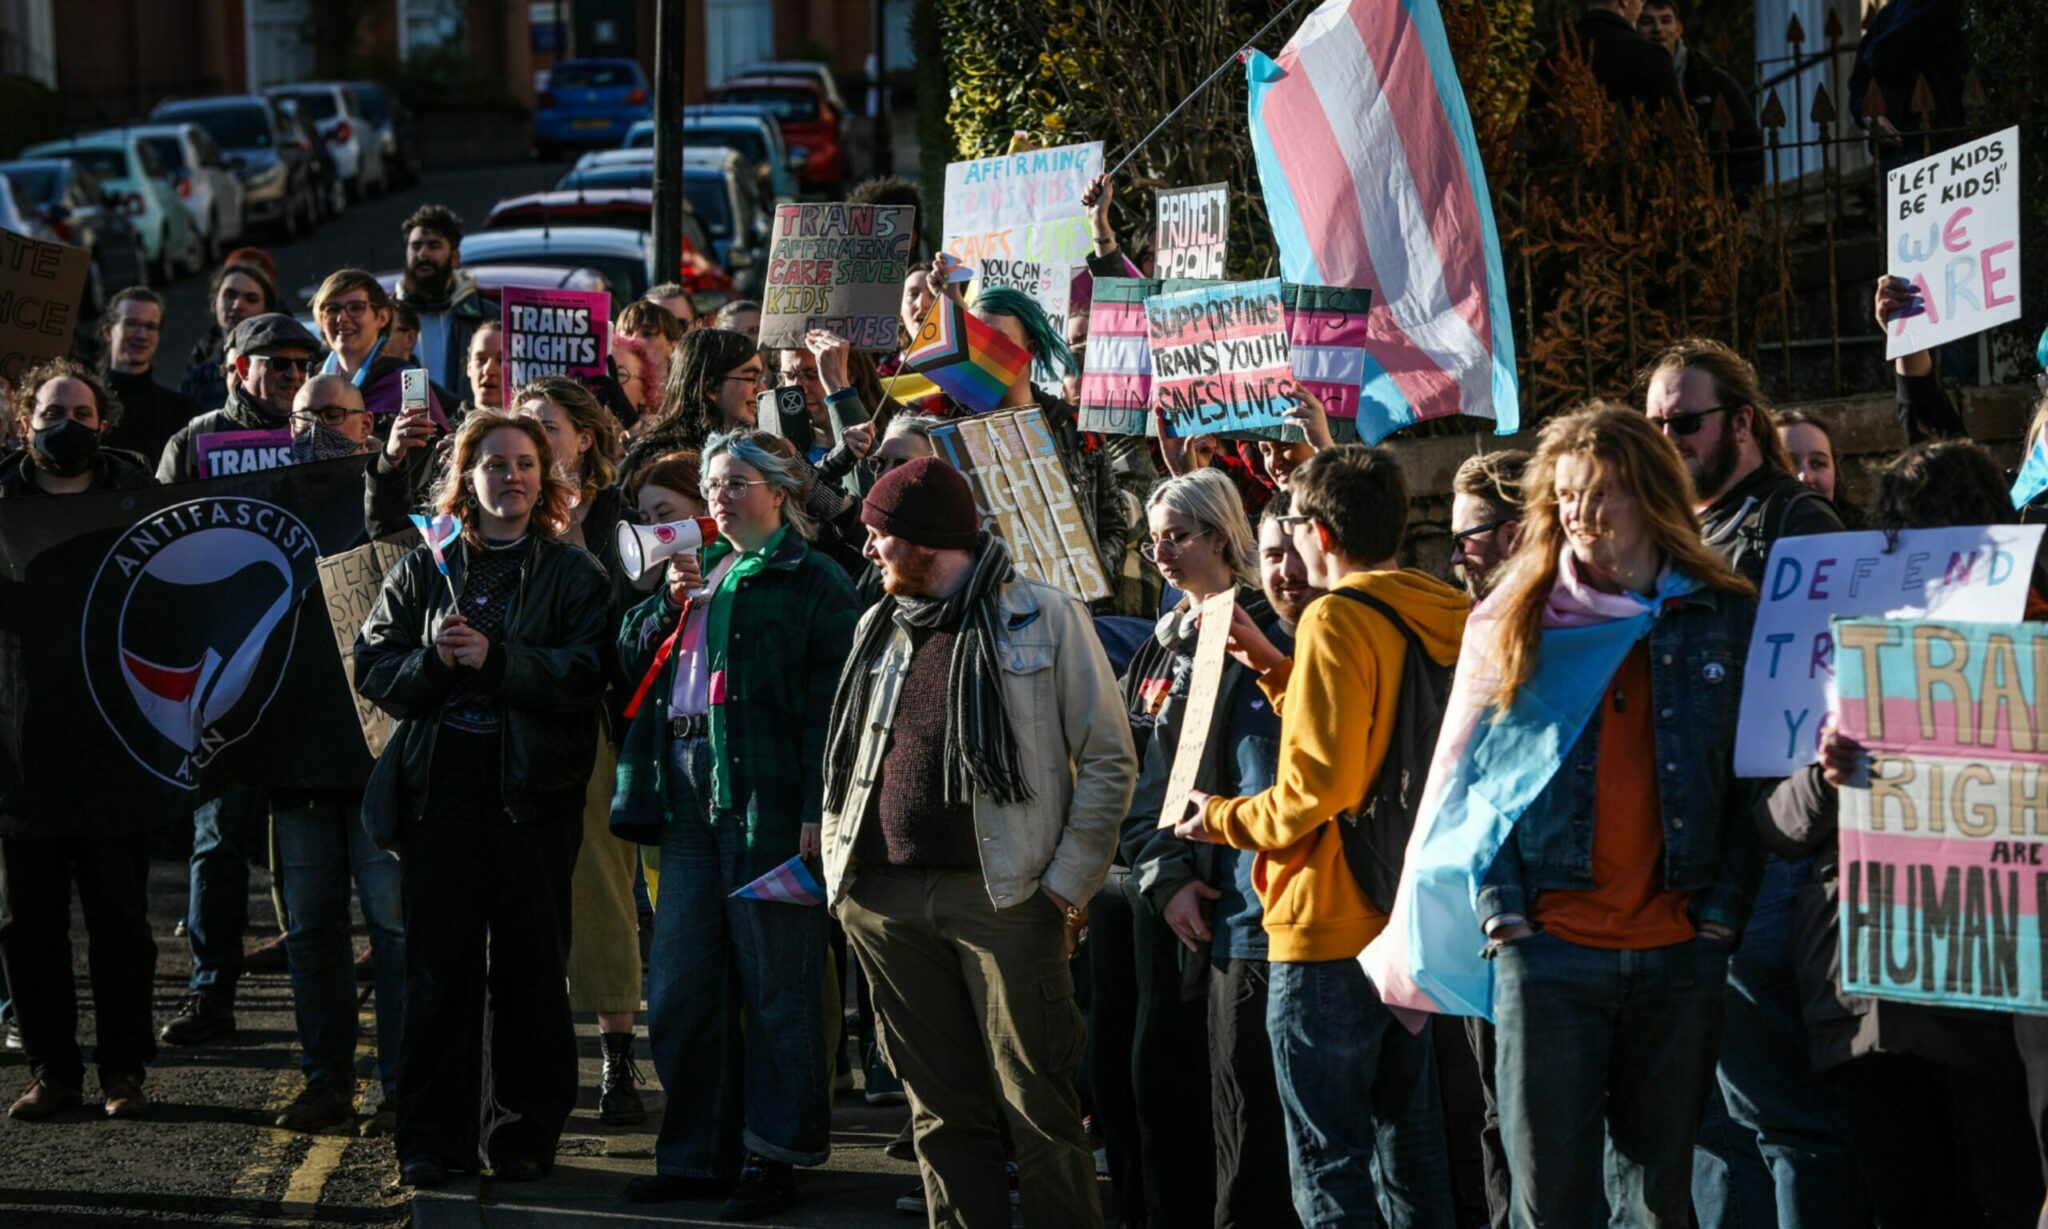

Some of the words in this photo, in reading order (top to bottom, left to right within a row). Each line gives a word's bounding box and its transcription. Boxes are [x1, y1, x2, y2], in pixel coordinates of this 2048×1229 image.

[964, 147, 1089, 185] AFFIRMING
[1950, 141, 2004, 176] KIDS
[952, 184, 1016, 214] TRANS
[1028, 177, 1075, 209] KIDS
[1899, 193, 1927, 220] BE
[777, 205, 899, 237] TRANS
[1158, 189, 1226, 249] PROTECT
[1898, 206, 1973, 263] WE
[772, 234, 910, 259] AFFIRMING
[948, 227, 1013, 267] SAVES
[768, 259, 832, 285] CARE
[835, 260, 906, 285] SAVES
[981, 259, 1009, 277] YOU
[1011, 260, 1040, 280] CAN
[766, 286, 834, 315] KIDS
[1895, 240, 2016, 337] ARE
[511, 305, 589, 335] TRANS
[1150, 293, 1279, 339] SUPPORTING
[511, 333, 596, 363] RIGHTS
[1152, 340, 1219, 377] TRANS
[1223, 332, 1289, 370] YOUTH
[1158, 380, 1227, 428] SAVES
[1230, 377, 1295, 419] LIVES
[208, 446, 292, 477] TRANS
[113, 501, 313, 579] ANTIFASCIST
[1770, 550, 2015, 602] DEFEND
[1990, 841, 2044, 865] ARE
[1848, 861, 2019, 997] HUMAN
